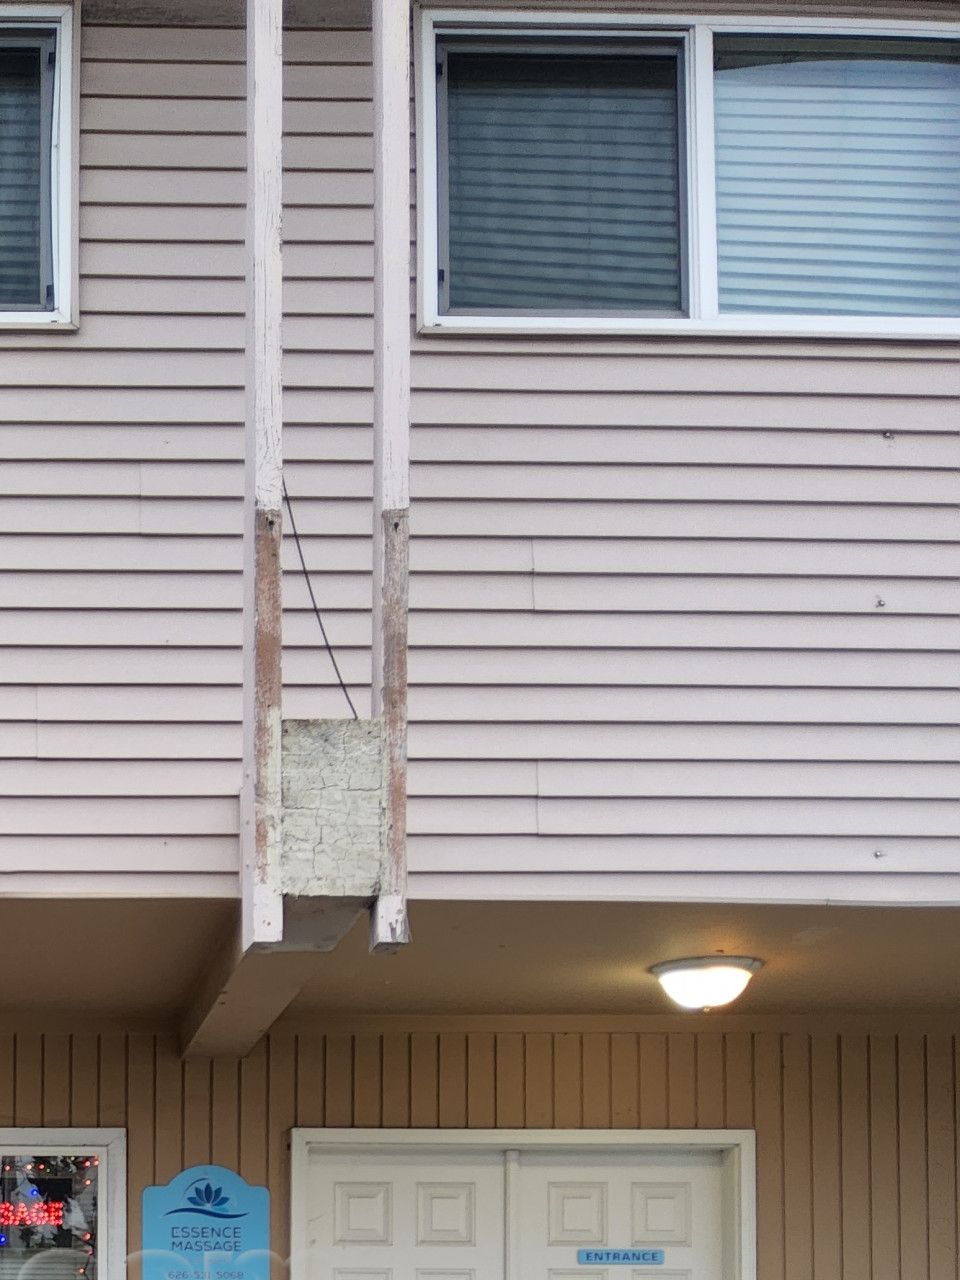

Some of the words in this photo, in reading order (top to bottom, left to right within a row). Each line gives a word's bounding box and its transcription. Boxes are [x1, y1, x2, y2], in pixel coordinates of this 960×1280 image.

[170, 1226, 243, 1239] ESSENCE
[170, 1240, 243, 1252] MASSAGE
[585, 1252, 659, 1261] ENTRANCE
